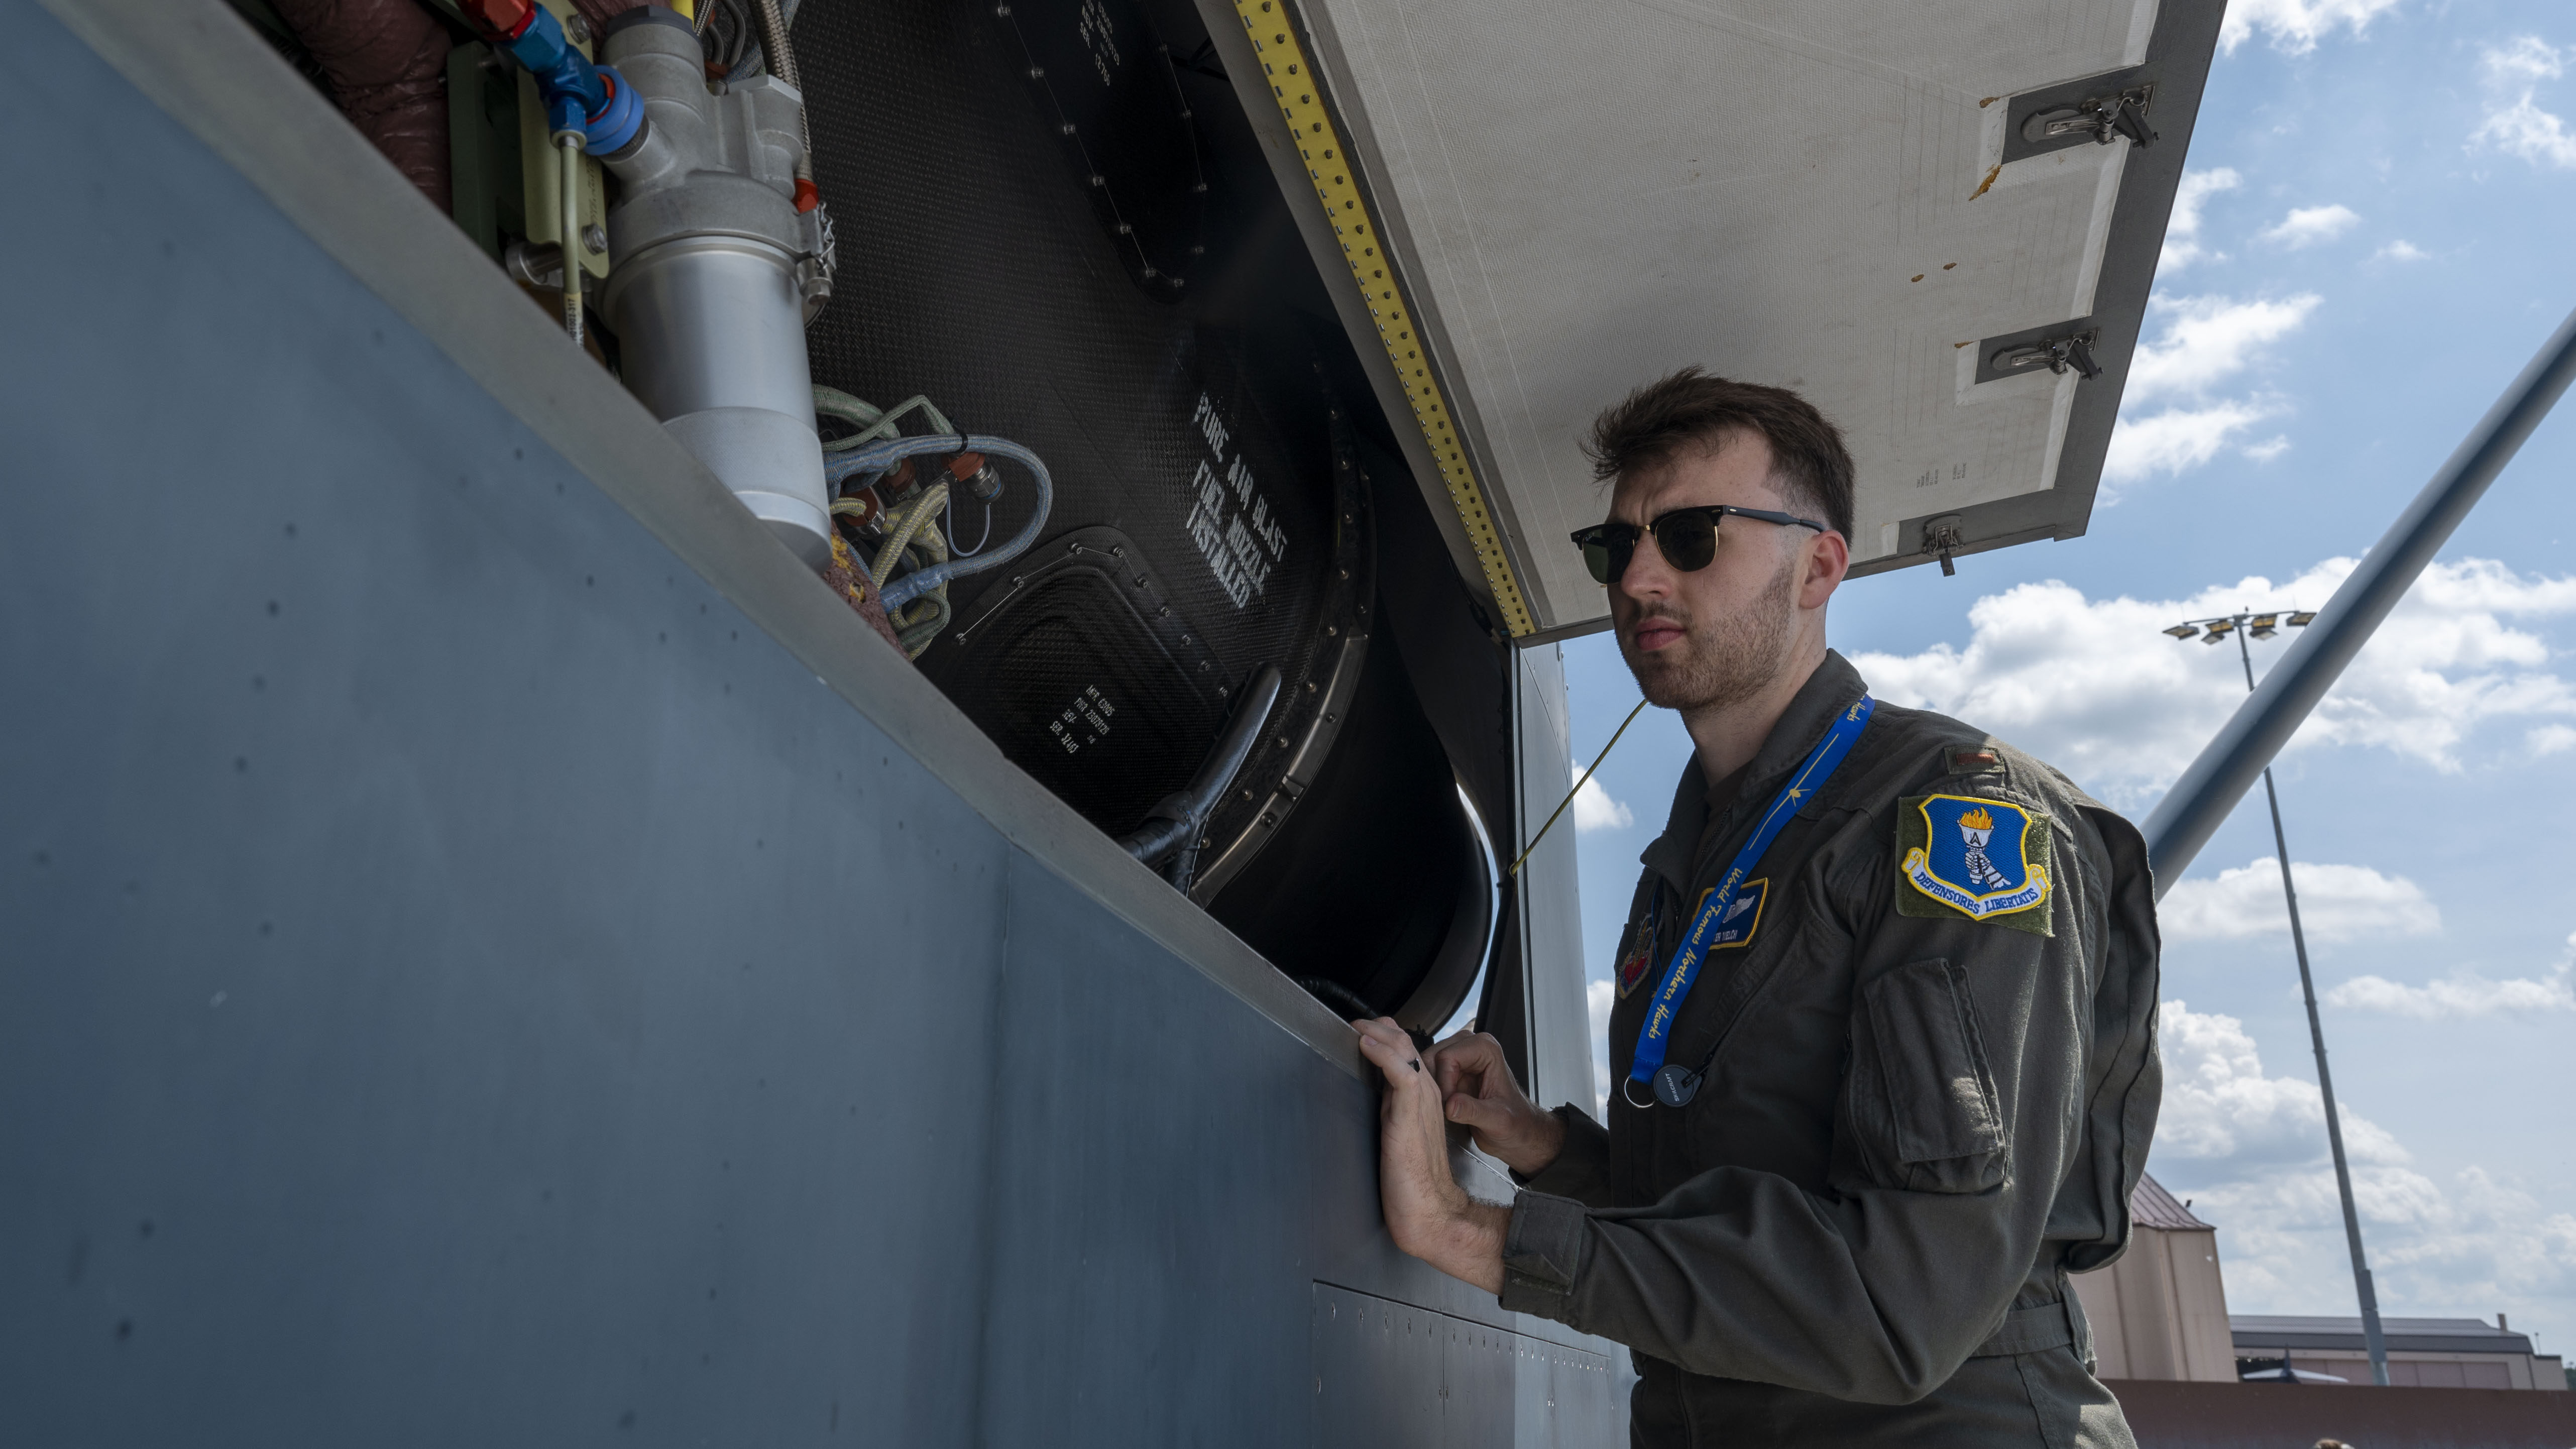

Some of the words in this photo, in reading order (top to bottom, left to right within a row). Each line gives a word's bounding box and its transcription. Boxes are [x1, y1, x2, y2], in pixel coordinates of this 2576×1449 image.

[1193, 392, 1229, 463] PURE
[1228, 454, 1253, 510] AIR
[1253, 494, 1287, 562] BLAST
[1193, 460, 1225, 525] FUEL
[1187, 502, 1251, 609] INSTALLED
[1074, 697, 1088, 712] PNR
[1717, 868, 1743, 904] World
[1914, 871, 1980, 914] DEFENSORES
[1985, 887, 2039, 913] LIBERTATIS
[1692, 905, 1722, 945] Famous
[1663, 947, 1697, 1001] Northern
[1648, 1004, 1669, 1039] Hawks
[1665, 1073, 1679, 1101] SKILCRAFT
